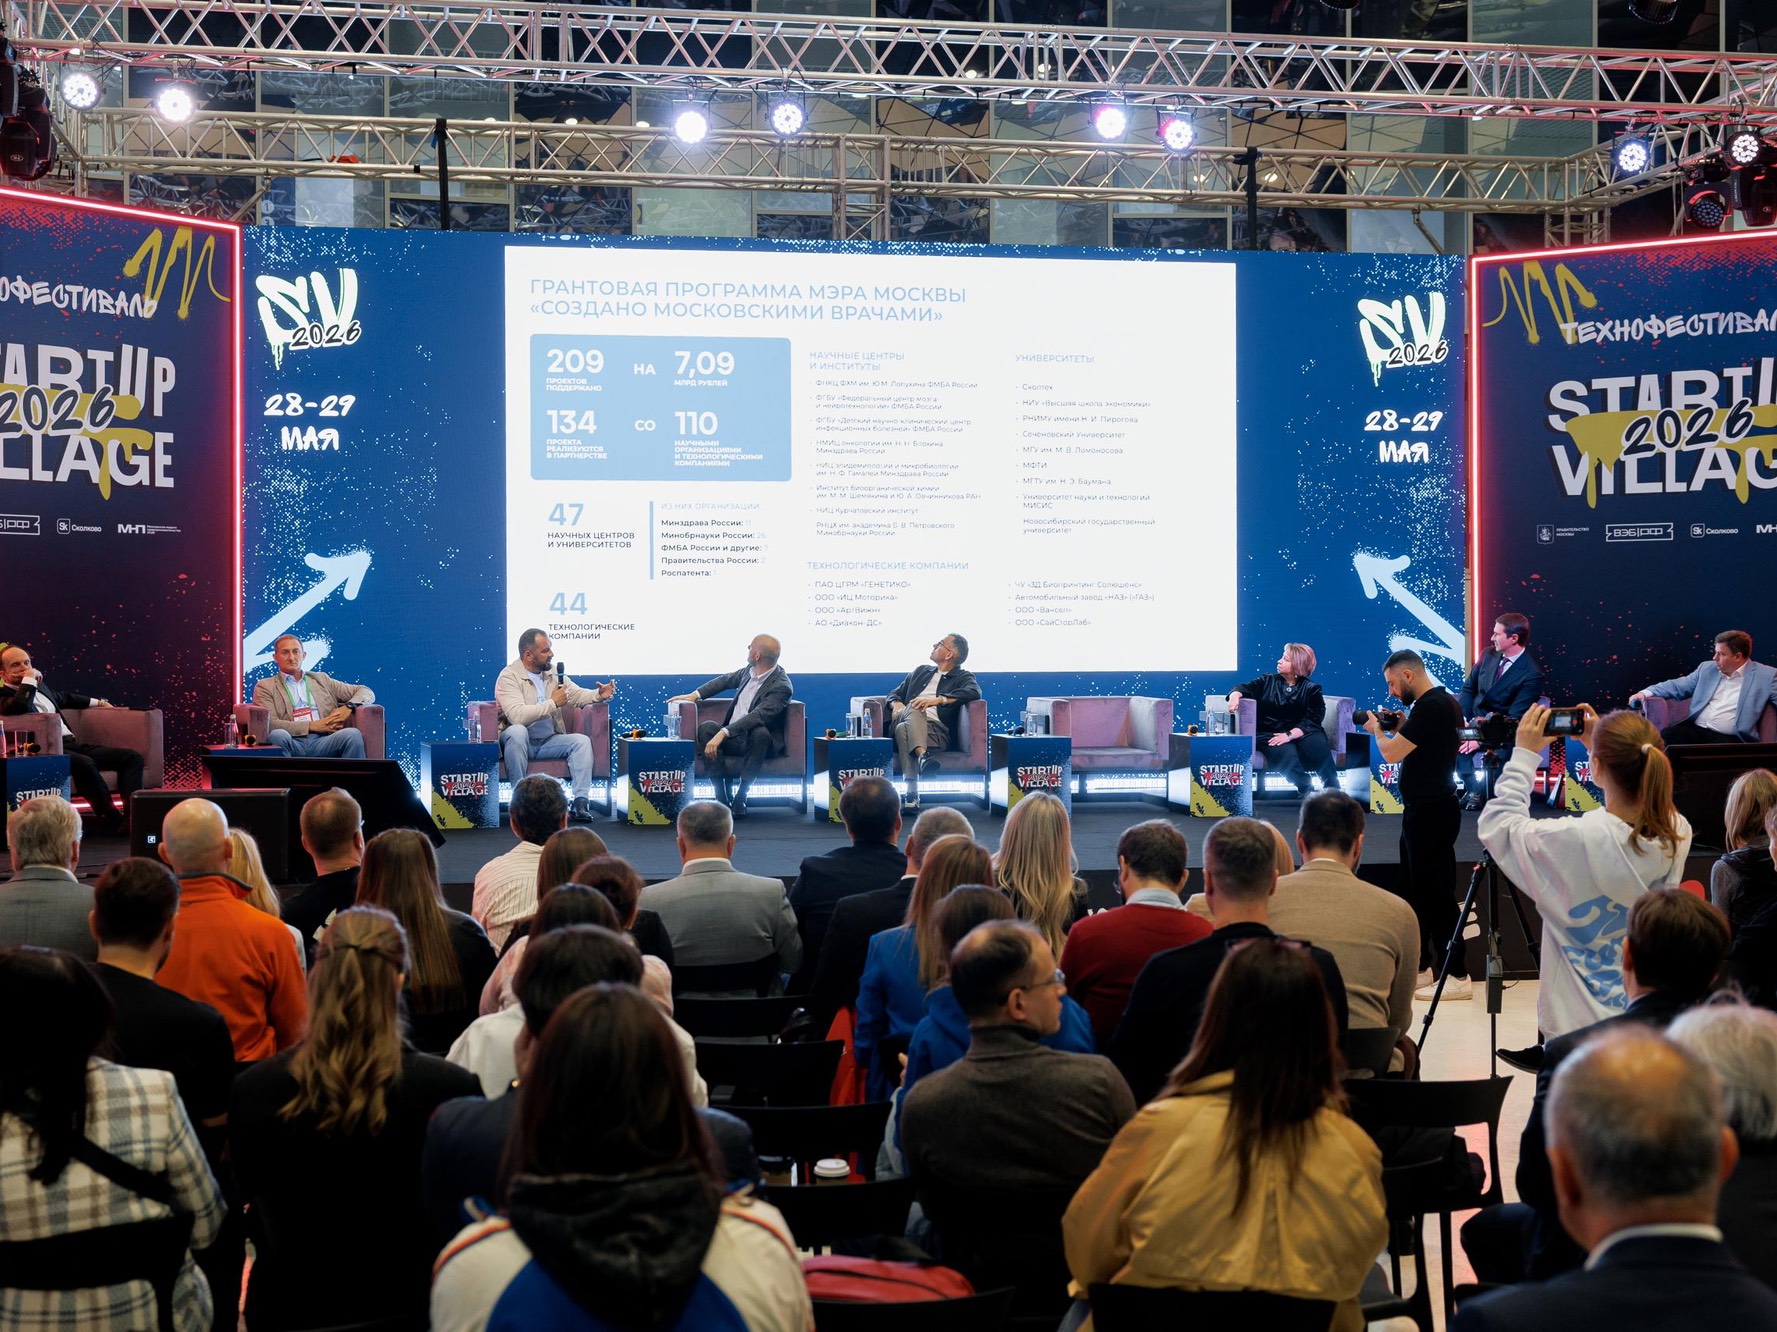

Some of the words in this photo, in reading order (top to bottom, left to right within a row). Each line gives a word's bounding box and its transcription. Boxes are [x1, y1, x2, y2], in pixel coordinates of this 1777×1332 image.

[531, 280, 657, 296] ГРАНТОВАЯ
[666, 282, 802, 299] ПРОГРАММА
[809, 285, 867, 300] МЭРА
[874, 287, 966, 303] МОСКВЫ
[531, 300, 647, 318] «СОЗДАНО
[654, 302, 823, 320] МОСКОВСКИМИ
[831, 306, 942, 322] ВРАЧАМИ»
[289, 320, 362, 350] 2026
[810, 352, 859, 360] НАУЧНЫЕ
[862, 352, 905, 360] ЦЕНТРЫ
[1015, 355, 1095, 363] УНИВЕРСИТЕТЫ
[1386, 340, 1448, 368] 2026
[546, 349, 604, 374] 209
[674, 351, 735, 378] 7,09
[633, 364, 656, 375] НА
[0, 343, 176, 417] ARTUP
[674, 379, 697, 387] МЛРД
[698, 378, 728, 387] РУБЛЕЙ
[546, 384, 602, 392] ПОДДЕРЖАНО
[264, 393, 356, 416] 28-29
[0, 385, 116, 438] 2026
[547, 410, 597, 434] 134
[634, 419, 656, 431] СО
[674, 411, 718, 435] 110
[1364, 410, 1443, 431] 28-29
[1619, 398, 1755, 461] 2026
[281, 426, 339, 450] МАЯ
[553, 452, 607, 460] ПАРТНЕРСТВЕ
[1379, 440, 1429, 464] МАЯ
[548, 503, 584, 526] 47
[71, 524, 102, 533] Сколково
[661, 519, 709, 527] Минздрава
[711, 519, 744, 527] России:
[593, 532, 635, 540] ЦЕНТРОВ
[661, 532, 720, 541] Минобрнауки
[1693, 527, 1702, 535] Sk
[661, 557, 725, 565] Правительства
[808, 562, 907, 570] ТЕХНОЛОГИЧЕСКИЕ
[910, 562, 969, 570] КОМПАНИИ
[661, 570, 711, 578] Роспатента:
[549, 592, 588, 615] 44
[549, 623, 635, 631] ТЕХНОЛОГИЧЕСКИЕ
[1017, 765, 1063, 777] STARTUP
[1200, 763, 1244, 776] STARTUP
[440, 772, 489, 785] STARTUP
[638, 770, 686, 783] STARTUP
[1018, 777, 1062, 788] VILLAGE
[1201, 775, 1244, 786] VILLAGE
[441, 783, 489, 795] VILLAGE
[640, 781, 687, 793] VILLAGE
